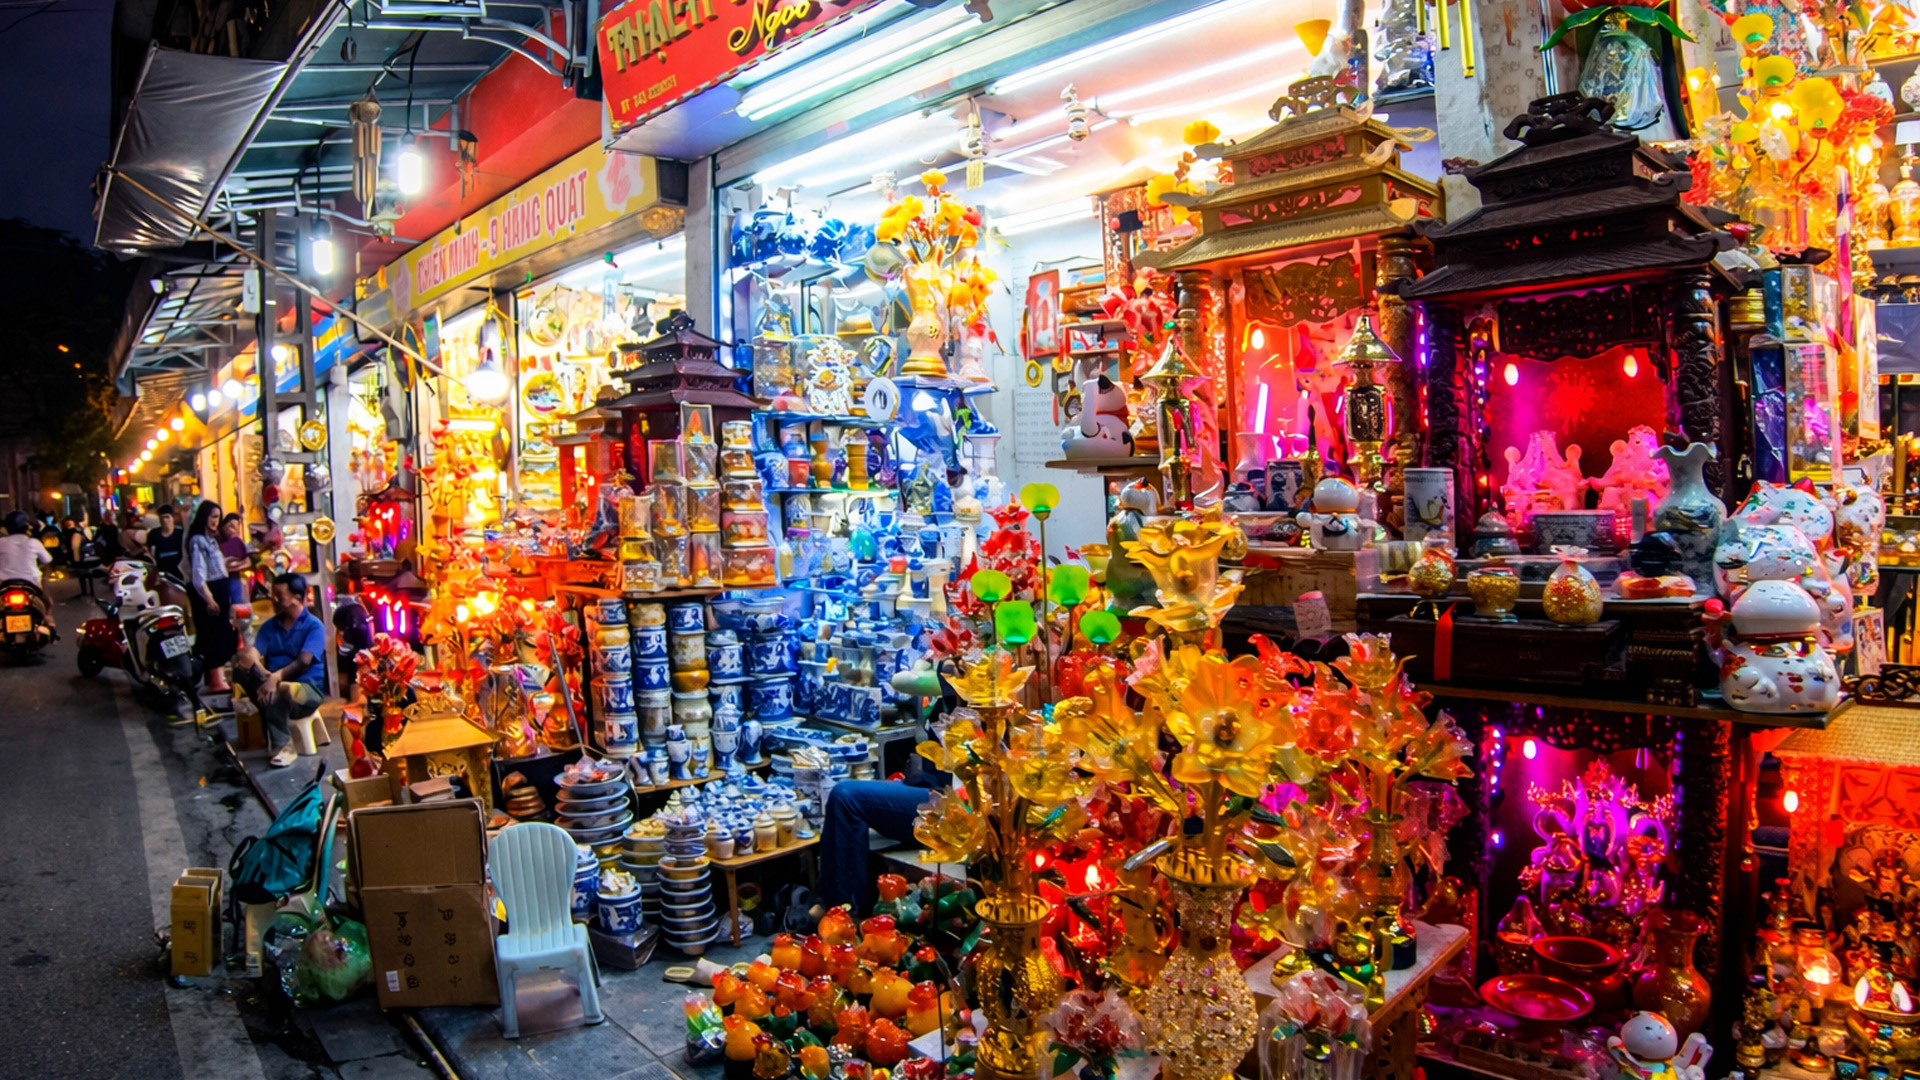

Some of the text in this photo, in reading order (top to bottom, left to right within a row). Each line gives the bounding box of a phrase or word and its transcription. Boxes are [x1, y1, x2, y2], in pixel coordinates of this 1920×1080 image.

[449, 228, 479, 278] MINH
[490, 217, 498, 257] 9
[545, 169, 588, 237] QUẠT
